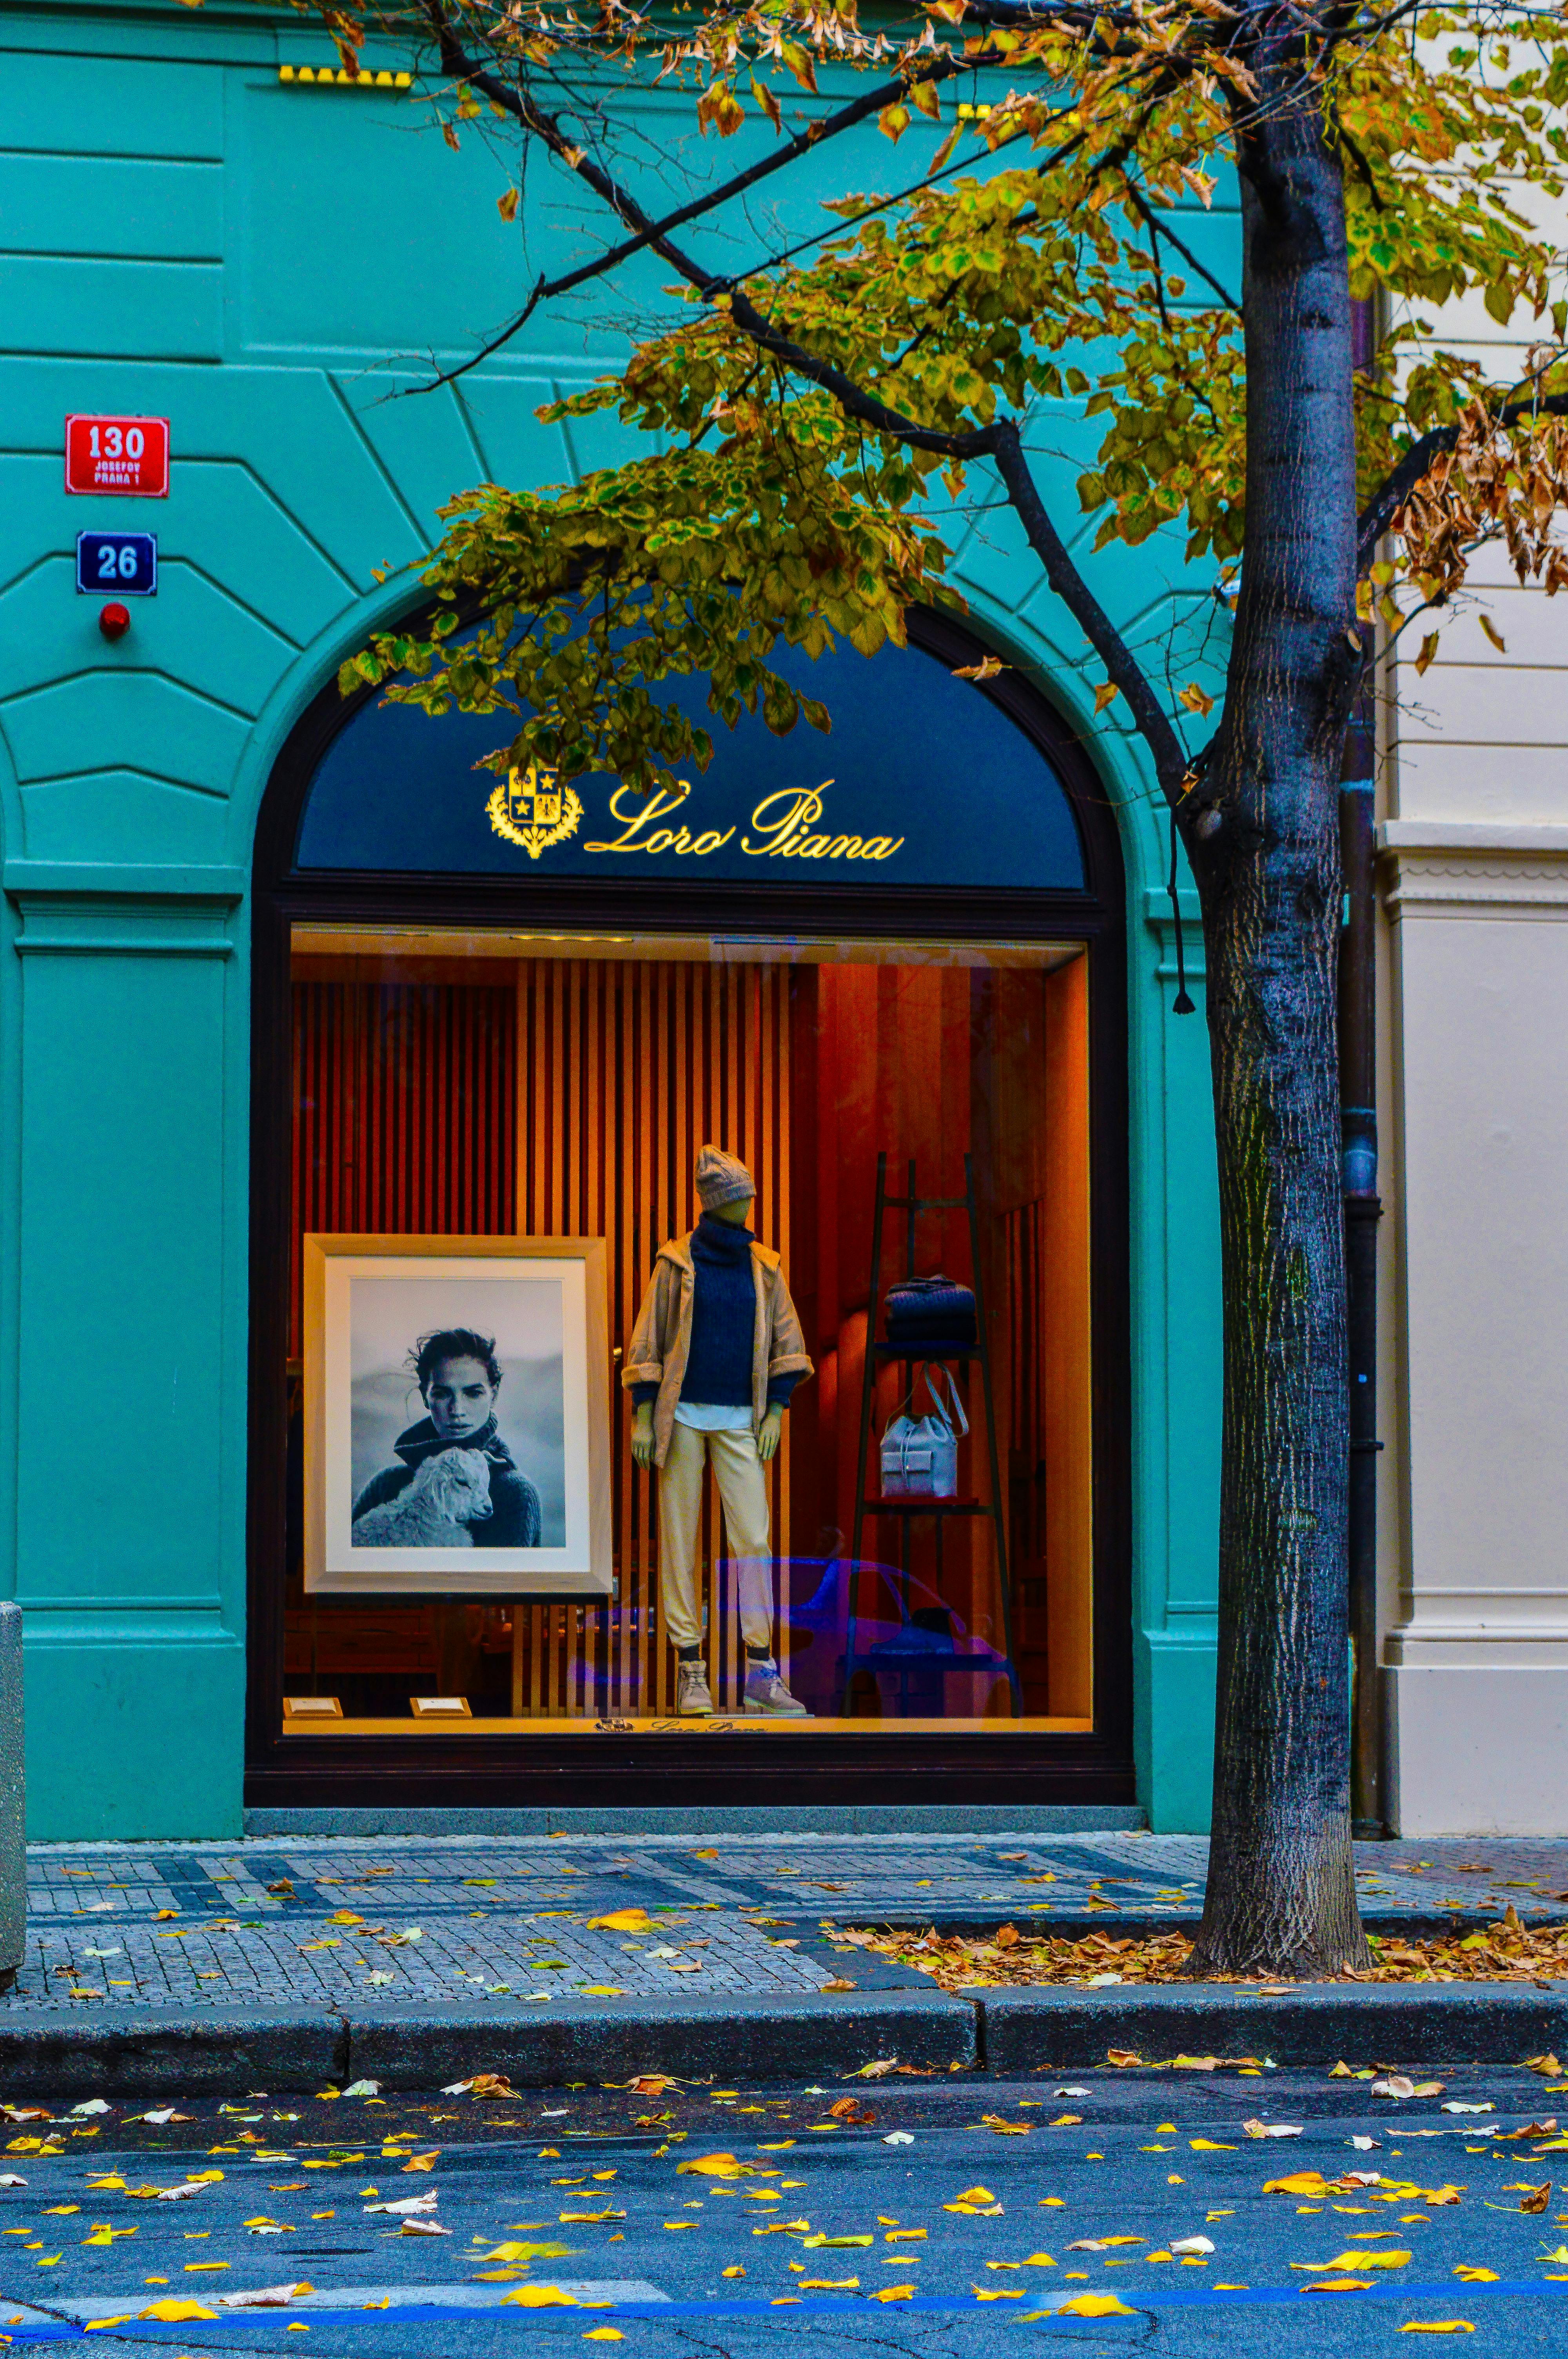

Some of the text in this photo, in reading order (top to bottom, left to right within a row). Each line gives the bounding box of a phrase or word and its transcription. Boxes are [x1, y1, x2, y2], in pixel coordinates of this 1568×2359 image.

[89, 425, 145, 459] 130
[94, 472, 139, 485] PRAHA 1
[98, 545, 137, 578] 26
[583, 779, 905, 860] Loro Piana
